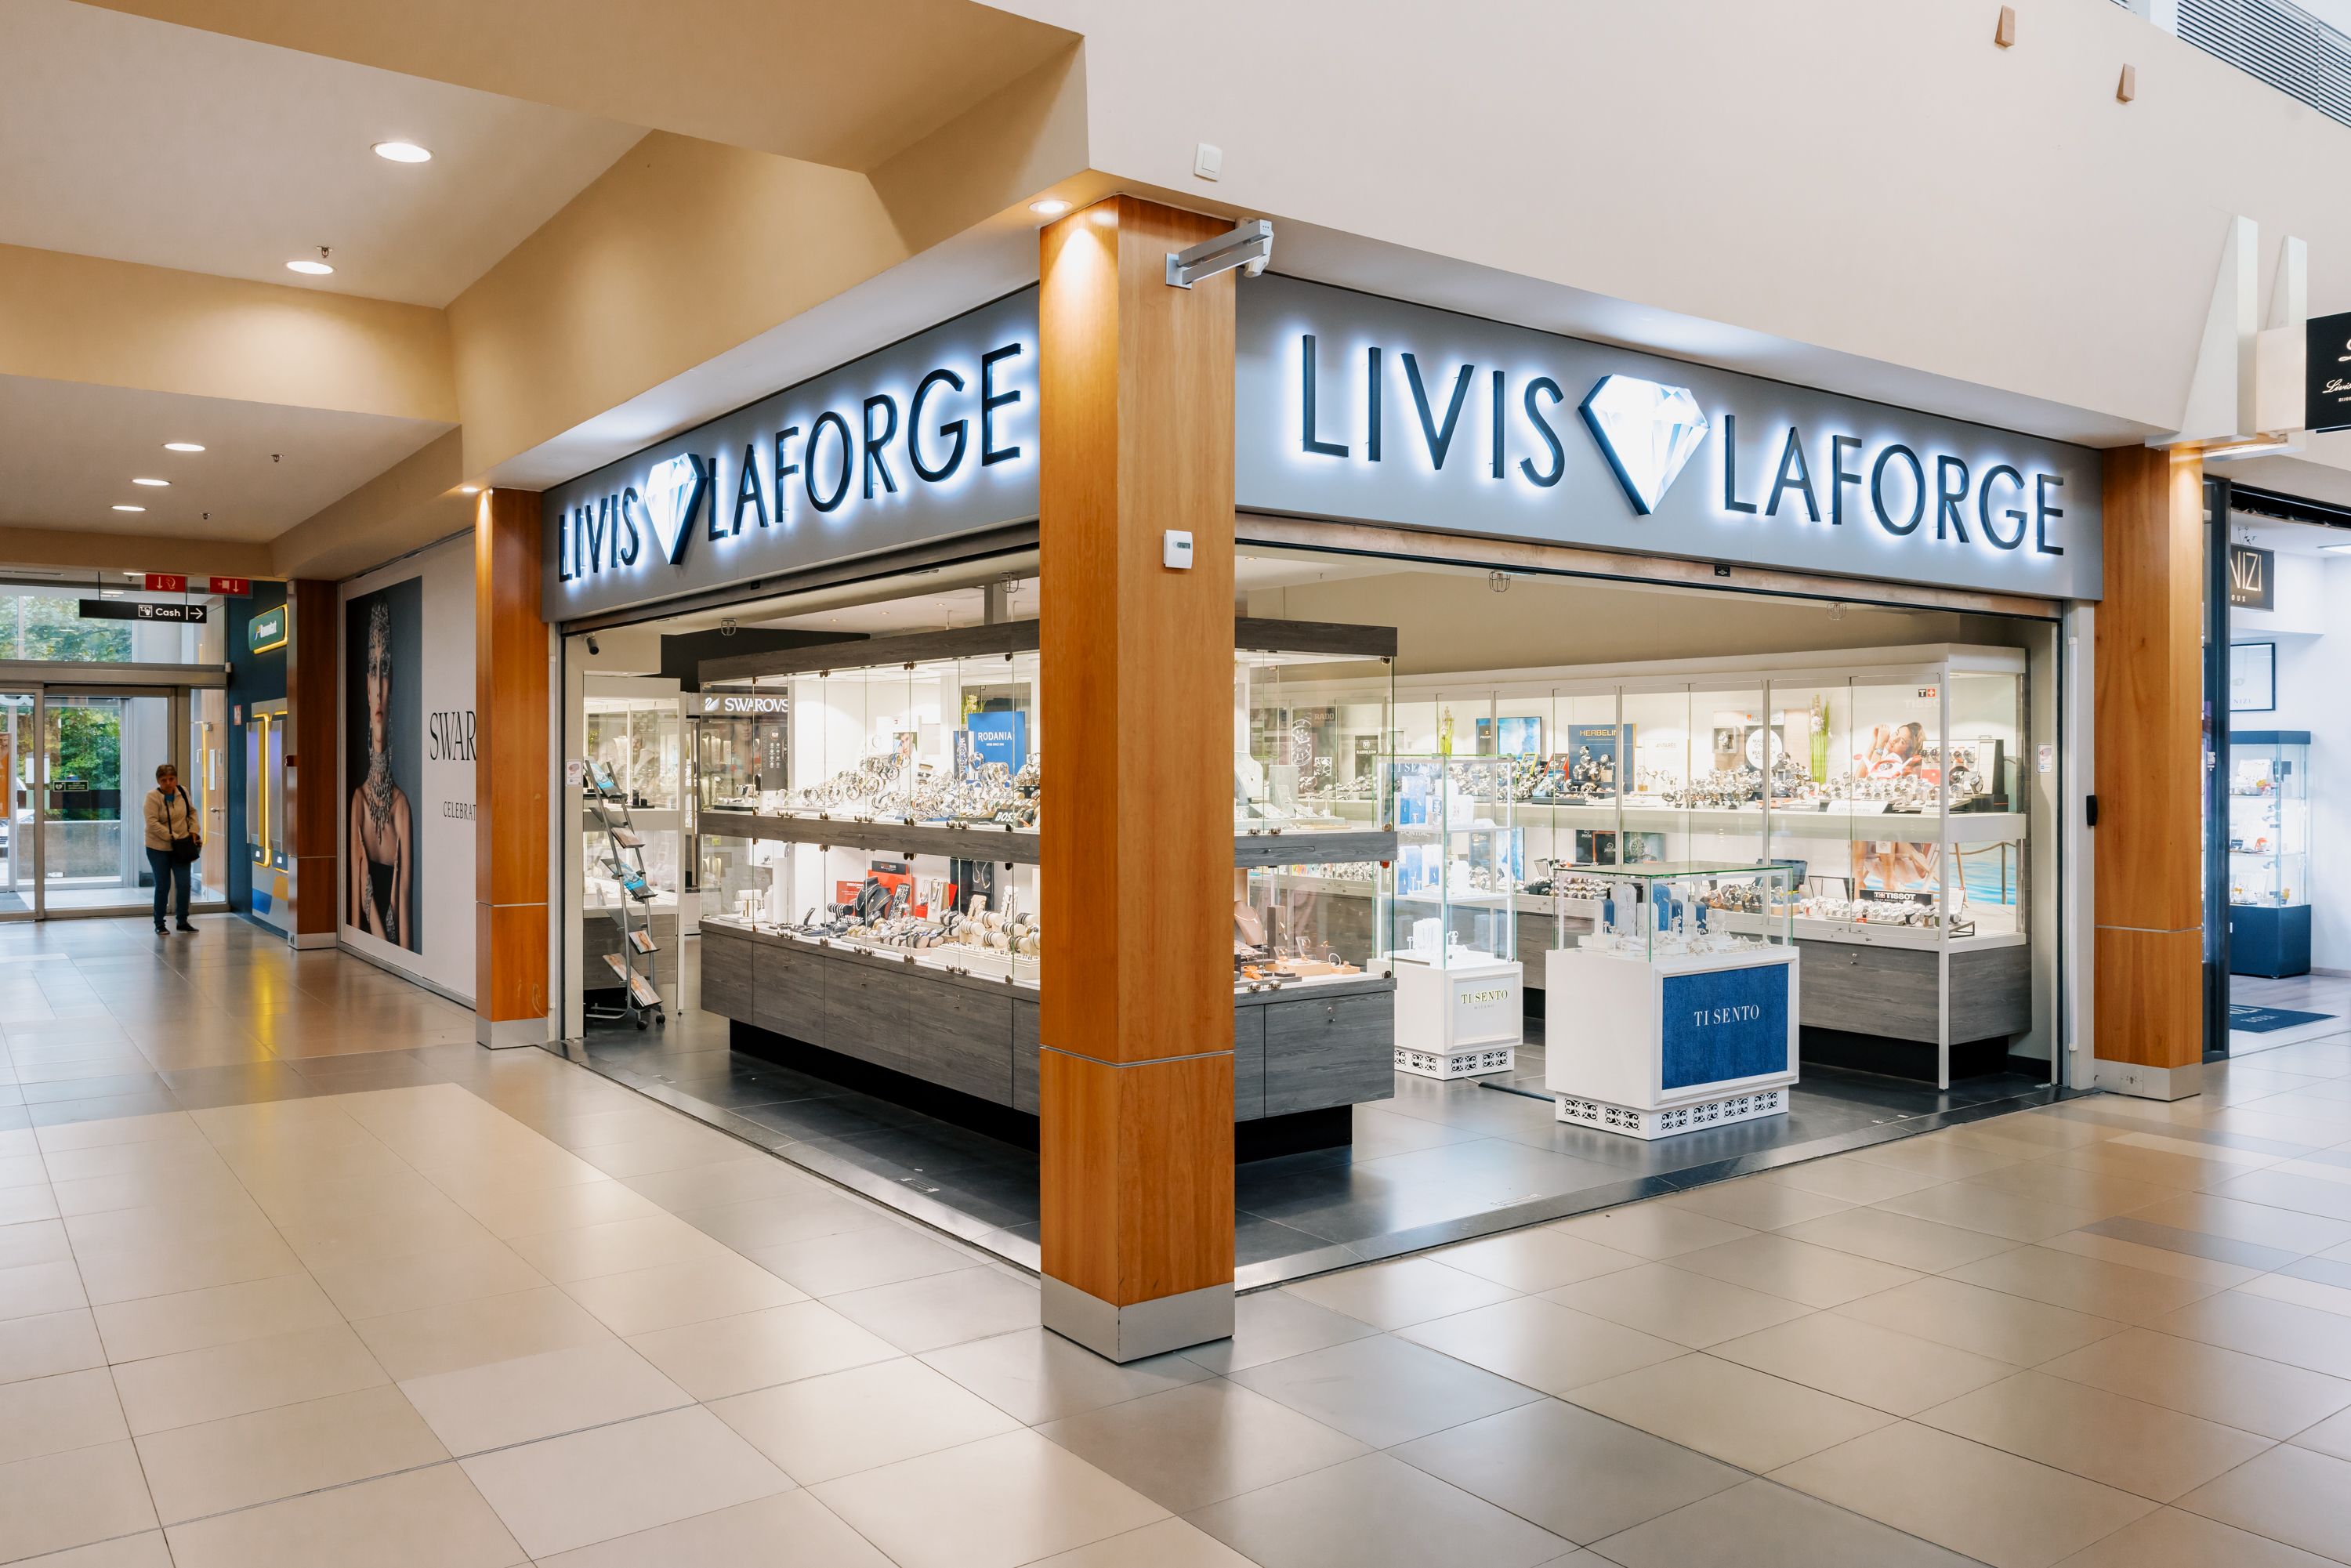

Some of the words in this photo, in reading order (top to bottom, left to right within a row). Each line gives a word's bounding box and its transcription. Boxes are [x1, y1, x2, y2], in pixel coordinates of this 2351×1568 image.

[1302, 334, 1566, 488] LIVIS
[1724, 414, 2064, 556] LAFORGE
[558, 487, 641, 582] LIVIS
[708, 342, 1023, 541] LAFORGE
[155, 607, 181, 617] Cash
[977, 731, 1012, 742] RODANIA
[1462, 994, 1471, 1004] TI
[1475, 990, 1508, 1002] SENTO
[1694, 1011, 1708, 1027] TI
[1713, 1004, 1759, 1024] SENTO
